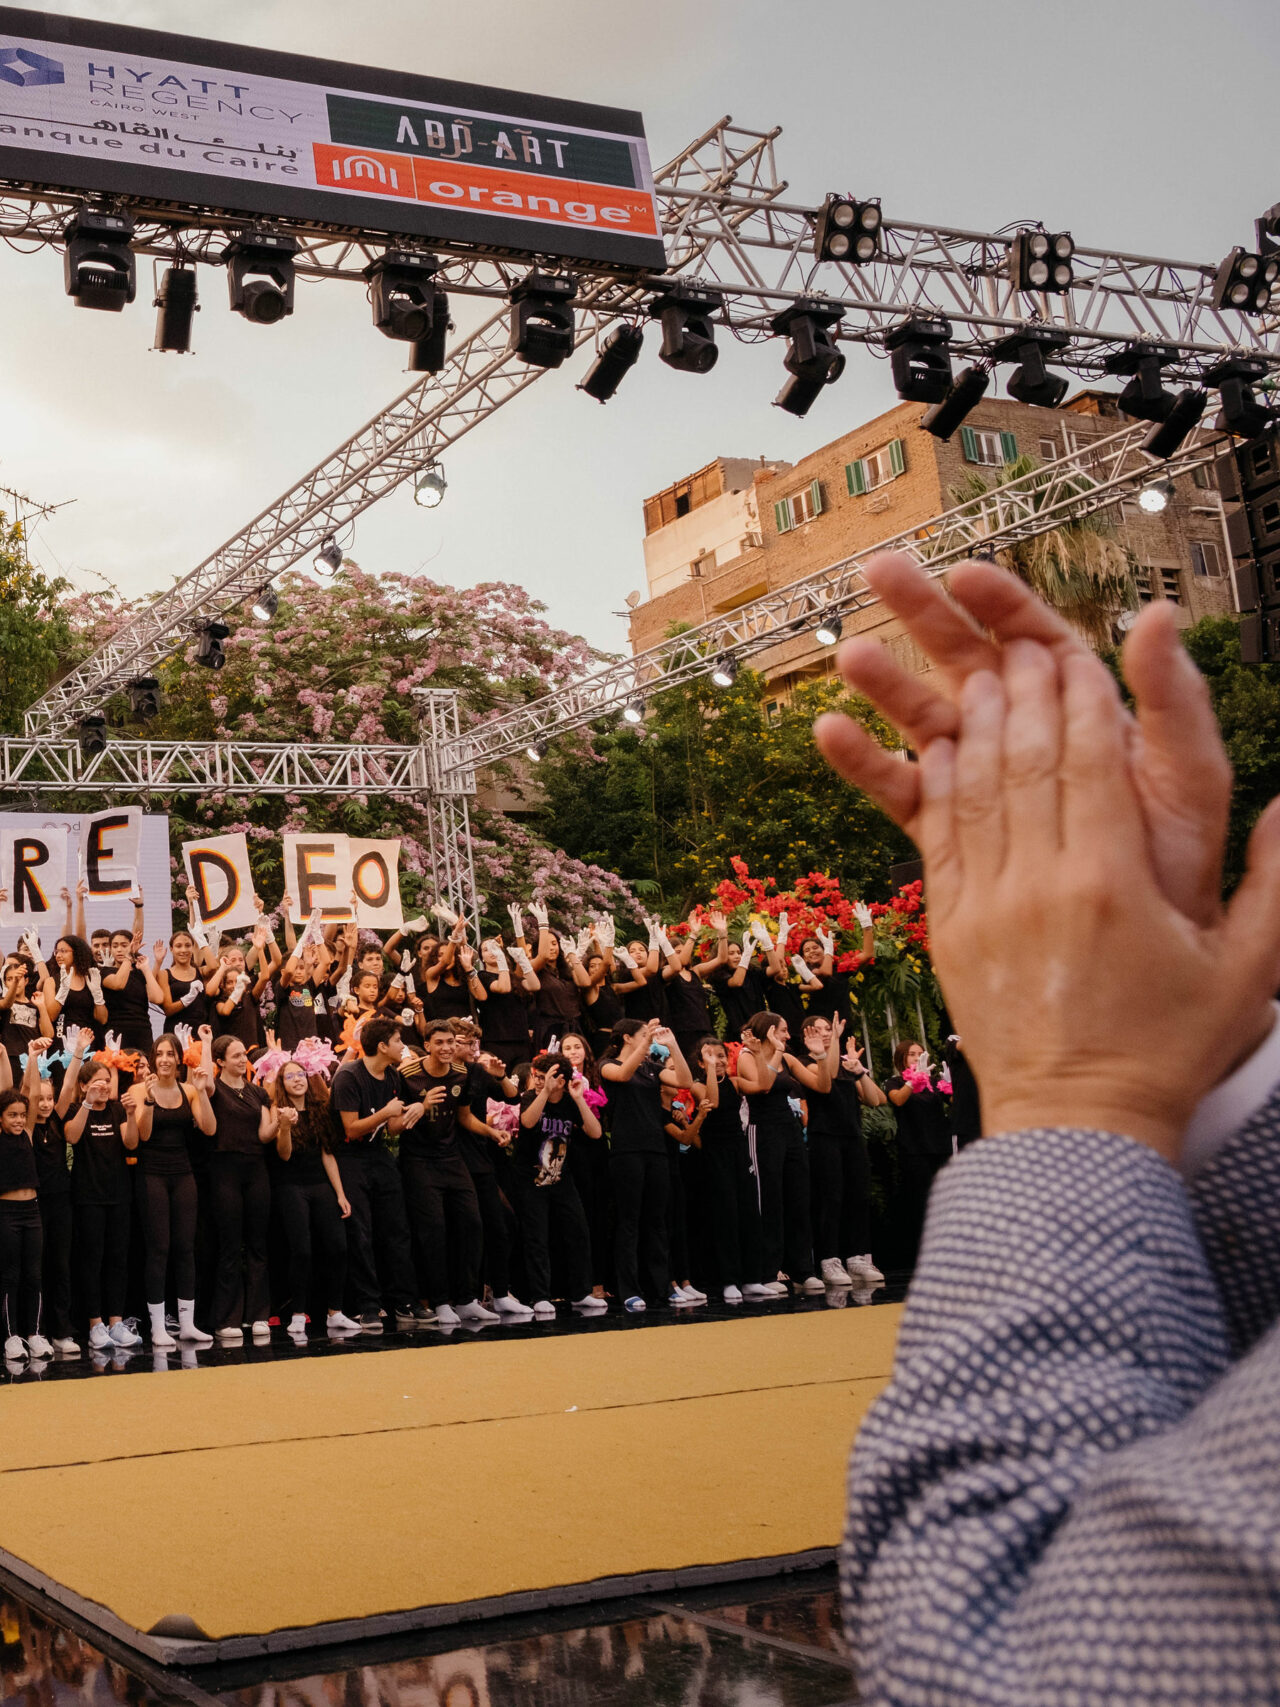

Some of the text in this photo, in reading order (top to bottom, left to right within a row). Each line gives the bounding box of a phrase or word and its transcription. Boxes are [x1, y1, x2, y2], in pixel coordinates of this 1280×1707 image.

[88, 62, 250, 99] HYATT
[89, 80, 304, 124] REGENCY
[90, 99, 201, 121] CAIRO WEST
[139, 141, 187, 159] du
[202, 150, 299, 175] Caire
[428, 180, 631, 223] orange
